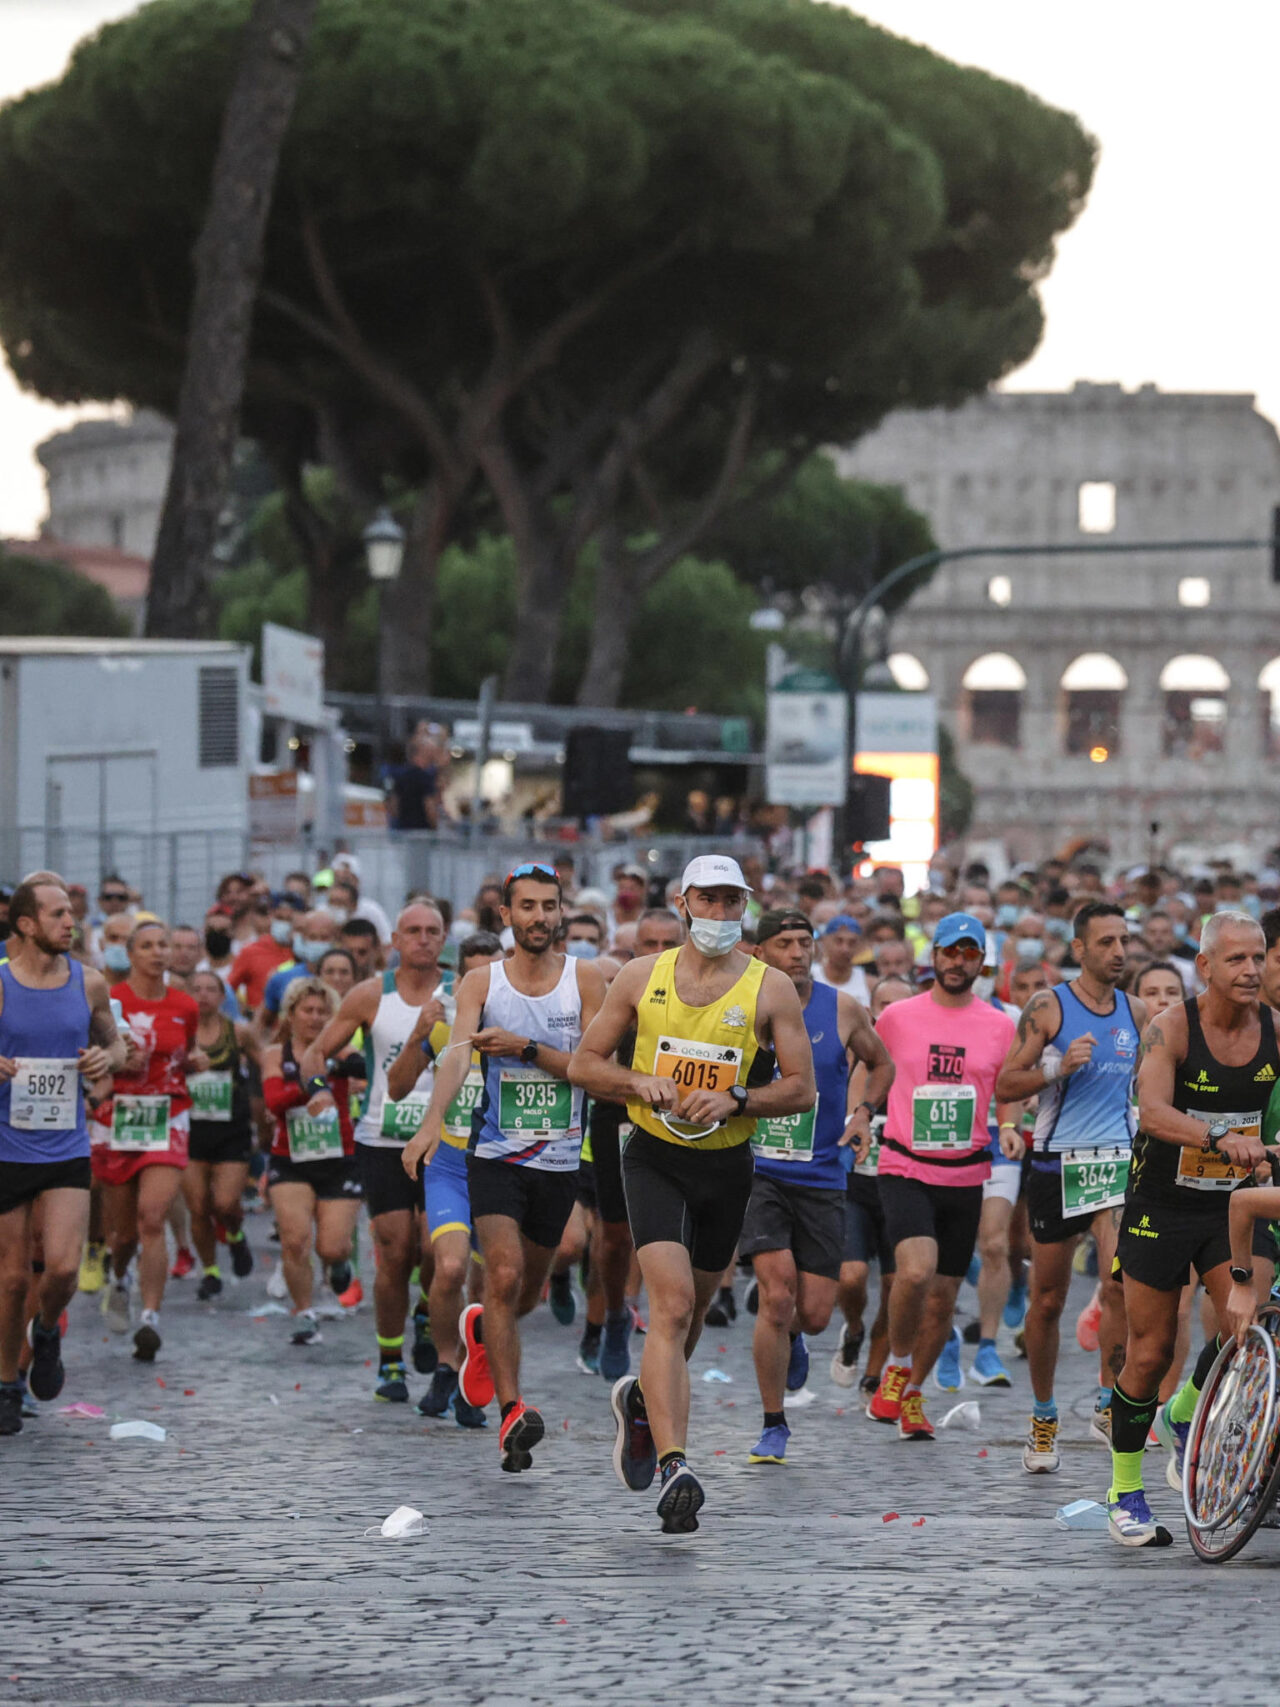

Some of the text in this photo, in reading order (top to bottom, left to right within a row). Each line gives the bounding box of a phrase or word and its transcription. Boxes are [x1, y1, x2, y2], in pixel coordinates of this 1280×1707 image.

[28, 1074, 65, 1095] 5892
[672, 1060, 719, 1090] 6015
[516, 1084, 557, 1107] 3935
[930, 1101, 958, 1122] 615
[1241, 1116, 1258, 1125] 2021
[515, 1117, 552, 1129] 6 B
[785, 1138, 793, 1149] B
[1078, 1163, 1117, 1187] 3642
[1197, 1165, 1235, 1178] 9 A
